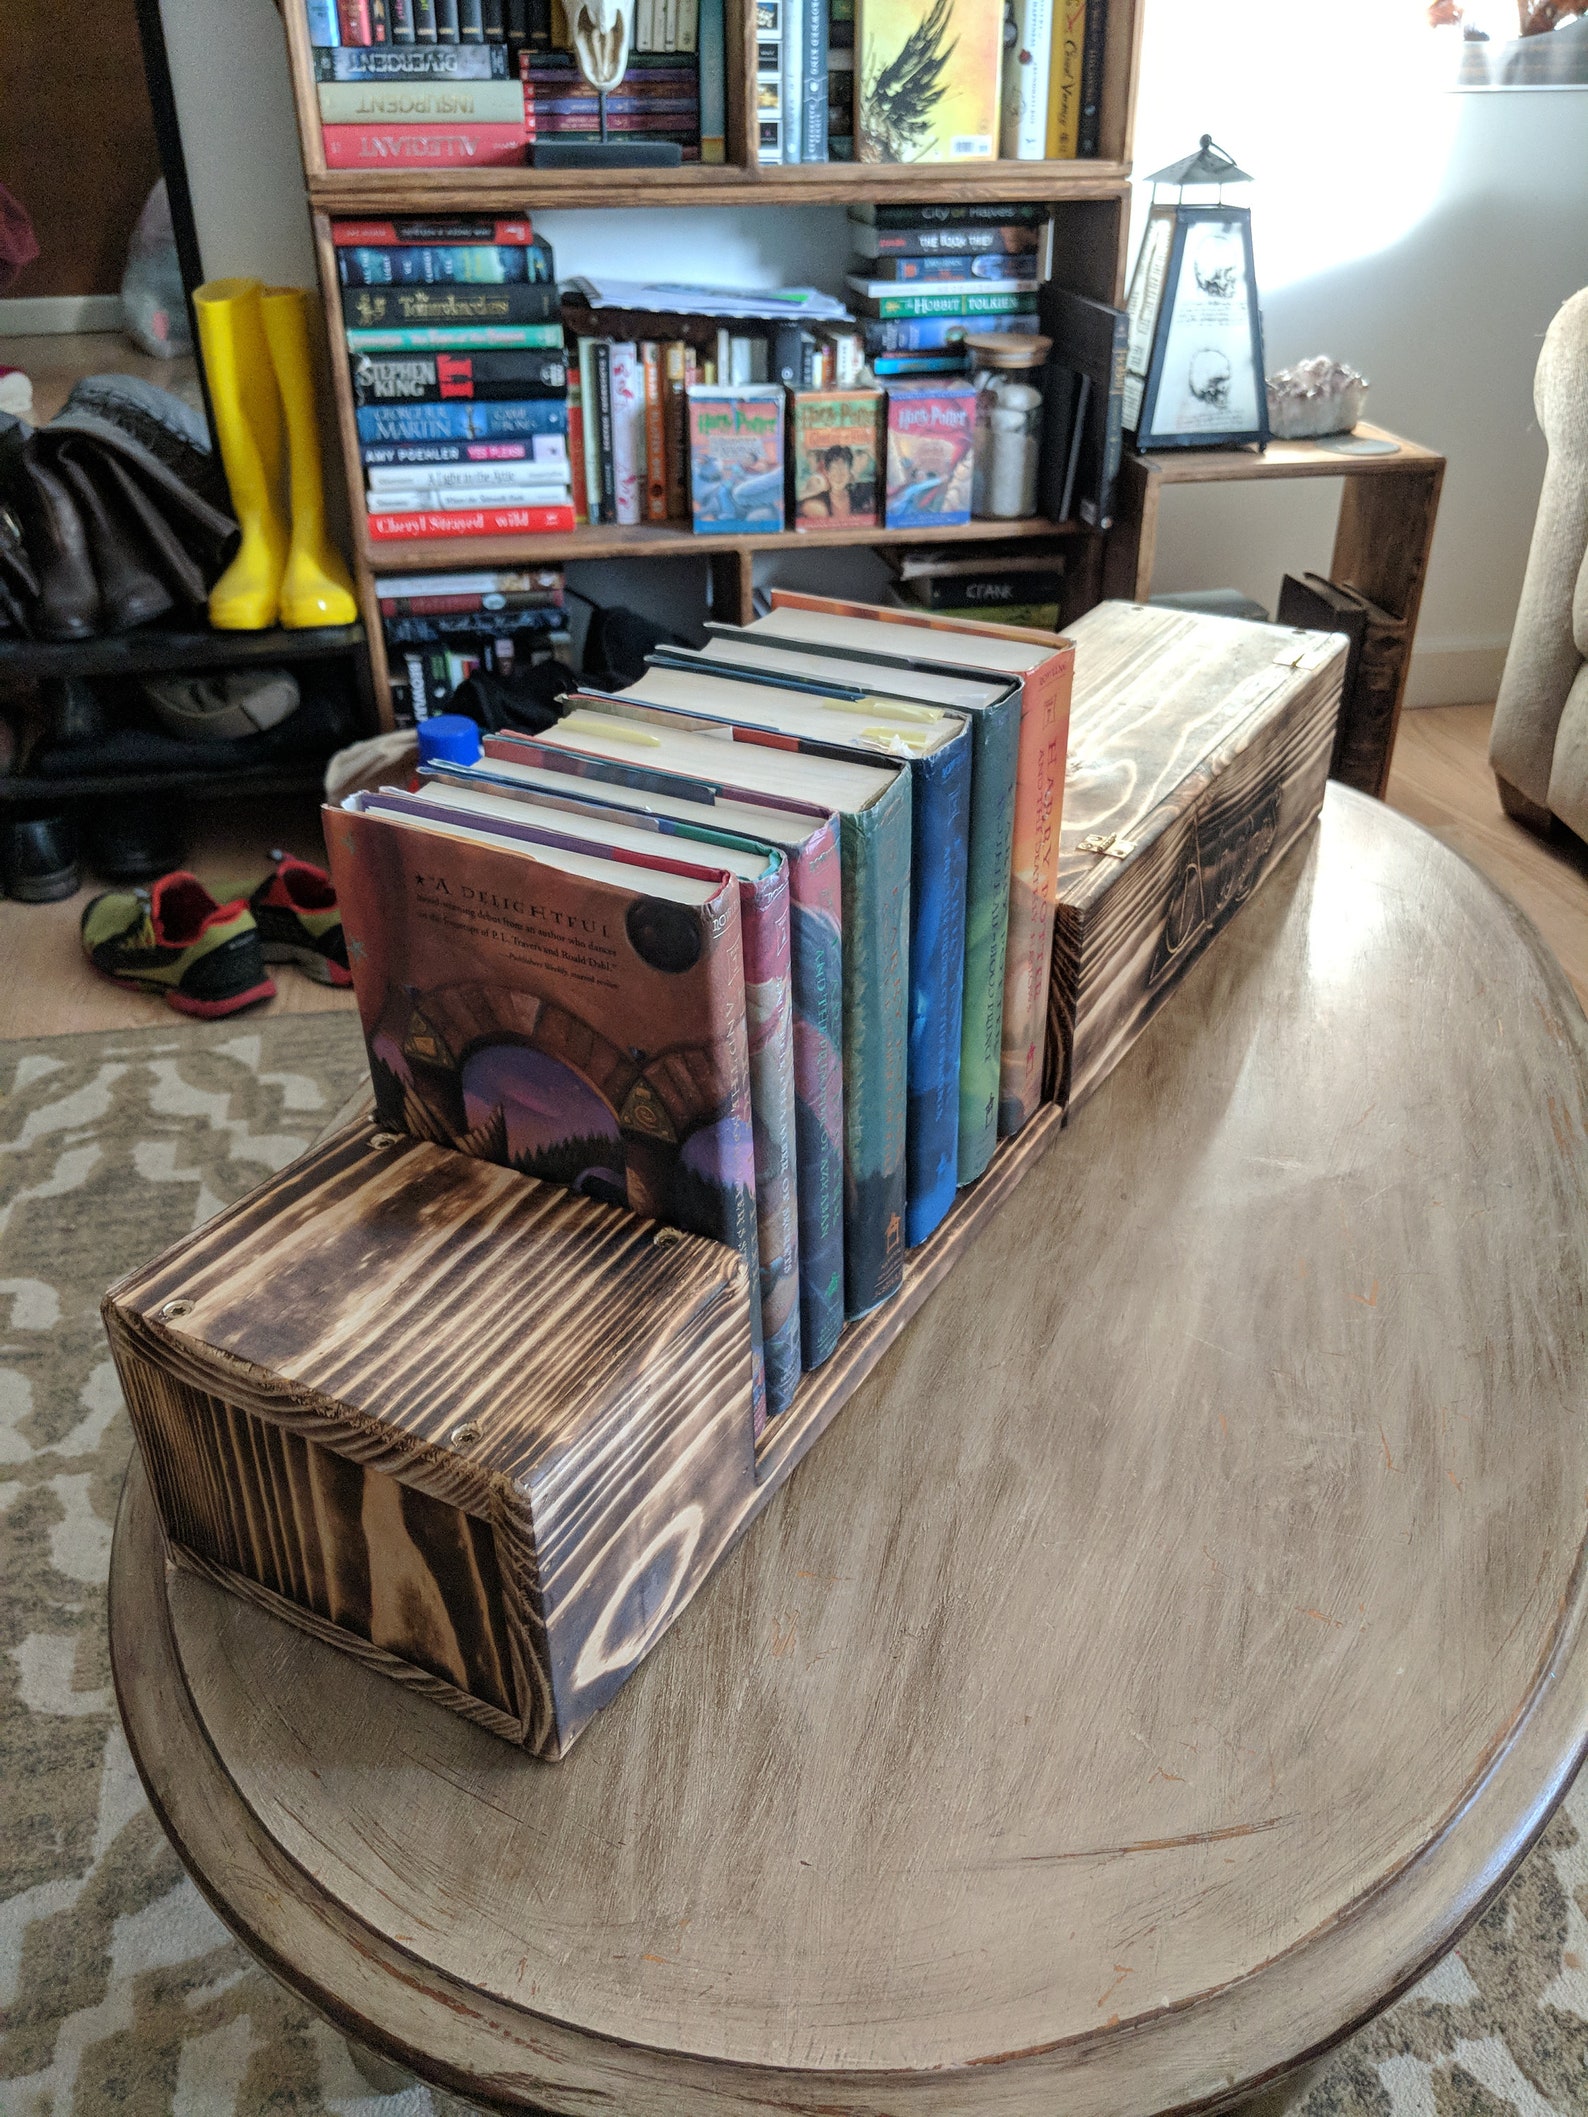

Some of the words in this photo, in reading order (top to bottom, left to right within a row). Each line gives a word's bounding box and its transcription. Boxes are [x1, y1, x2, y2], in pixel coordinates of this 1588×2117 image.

[348, 53, 458, 73] DIVERGENT
[809, 48, 820, 75] KING
[356, 93, 475, 114] INSURGENT
[360, 135, 480, 157] ALLEGIANT
[939, 231, 967, 248] BOOK
[967, 297, 1018, 311] TOLKIEN
[360, 361, 436, 386] STEPHEN
[374, 380, 425, 398] KING
[929, 404, 967, 427] Potter
[376, 420, 451, 440] MARTIN
[365, 448, 395, 463] AMY
[399, 446, 460, 461] POEHLER
[467, 446, 489, 460] YES
[490, 445, 525, 459] PLEASE
[376, 514, 427, 536] Cheryl
[429, 512, 485, 534] Strayed
[494, 511, 530, 528] wild
[407, 660, 429, 722] BEOWUL
[1042, 737, 1058, 868] HARRY
[460, 885, 610, 940] DELIGHTFUL
[480, 926, 490, 938] of
[511, 933, 542, 953] Travers
[543, 946, 560, 957] and
[560, 949, 587, 966] Roald
[502, 916, 523, 931] from
[538, 928, 565, 942] author
[568, 936, 586, 949] who
[587, 940, 617, 957] dances
[1032, 883, 1051, 1002] POTTER
[815, 949, 827, 993] AND
[817, 993, 829, 1035] THE
[725, 1001, 738, 1055] AND
[819, 1131, 829, 1153] OF
[781, 1177, 791, 1202] OF
[819, 1158, 830, 1240] AZKABAN
[781, 1207, 794, 1274] SECRETS
